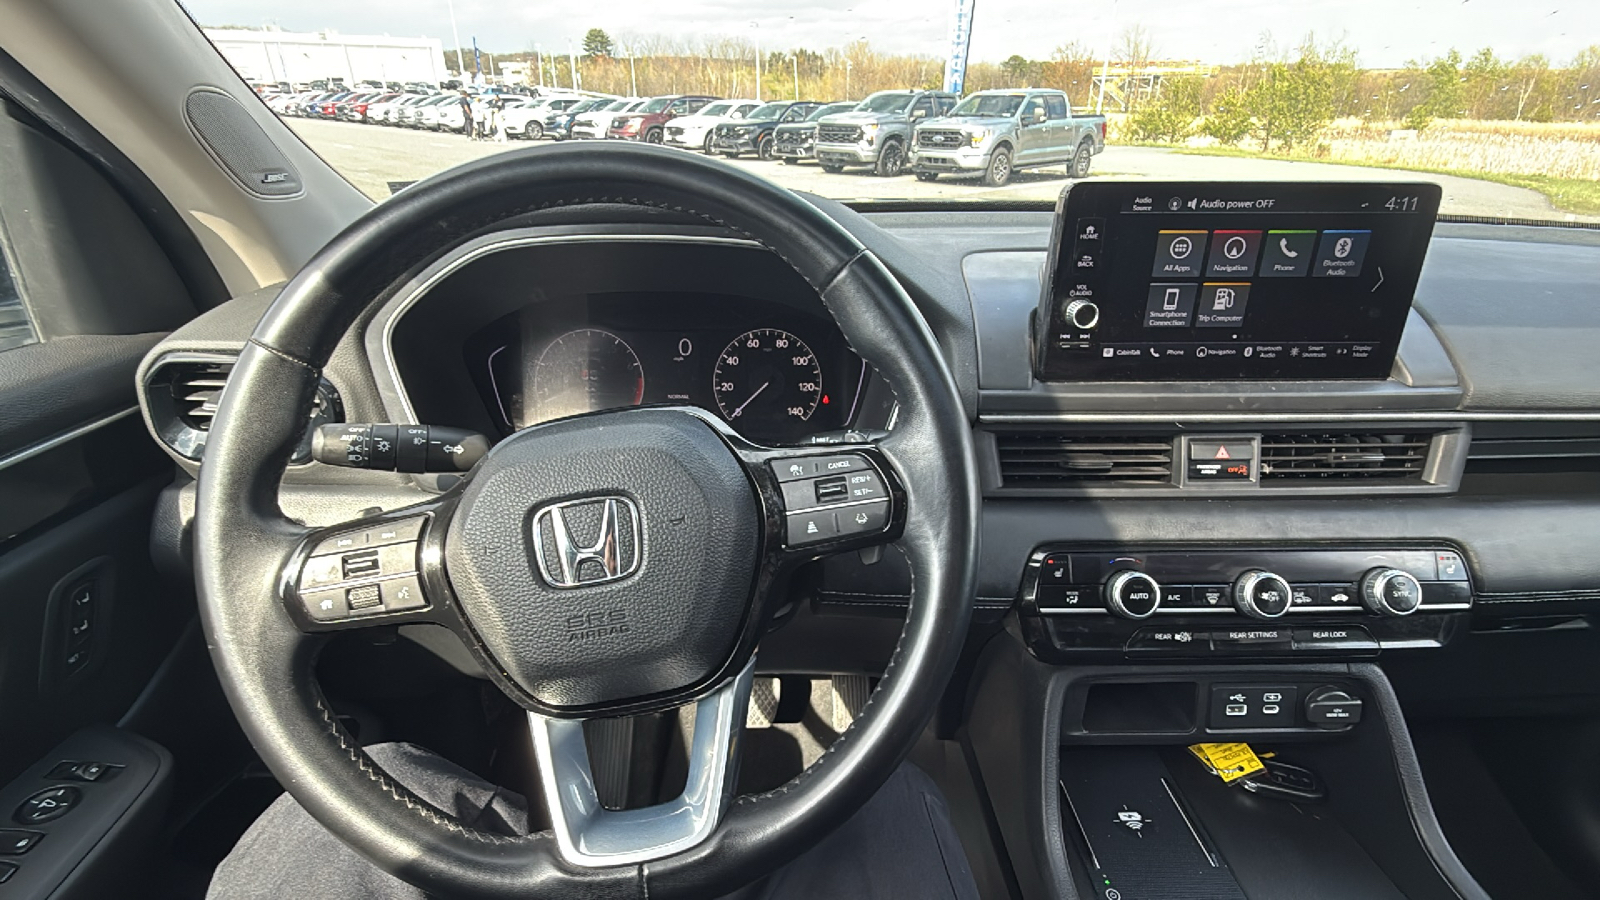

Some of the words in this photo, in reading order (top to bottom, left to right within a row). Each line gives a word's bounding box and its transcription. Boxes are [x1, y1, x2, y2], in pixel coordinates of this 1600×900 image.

[1200, 199, 1226, 208] Audio
[1226, 201, 1254, 210] power
[1255, 199, 1275, 209] OFF
[1384, 196, 1419, 211] 4:11
[1322, 259, 1356, 267] Bluetooth
[1175, 265, 1191, 273] Apps
[1213, 264, 1248, 273] Navigation
[1326, 268, 1347, 276] Audio
[1149, 310, 1188, 320] Smartphone
[1198, 314, 1211, 323] Trip
[1211, 314, 1243, 323] Computer
[746, 339, 760, 348] 60
[775, 339, 788, 348] 80
[726, 356, 739, 365] 40
[791, 356, 808, 365] 100
[721, 382, 734, 391] 20
[798, 382, 815, 391] 120
[786, 407, 804, 416] 140
[827, 460, 851, 470] CANCEL
[1129, 592, 1149, 600] AUTO
[569, 624, 631, 641] AIRBAG
[1229, 631, 1247, 639] REAR
[1247, 631, 1278, 639] SETTINGS
